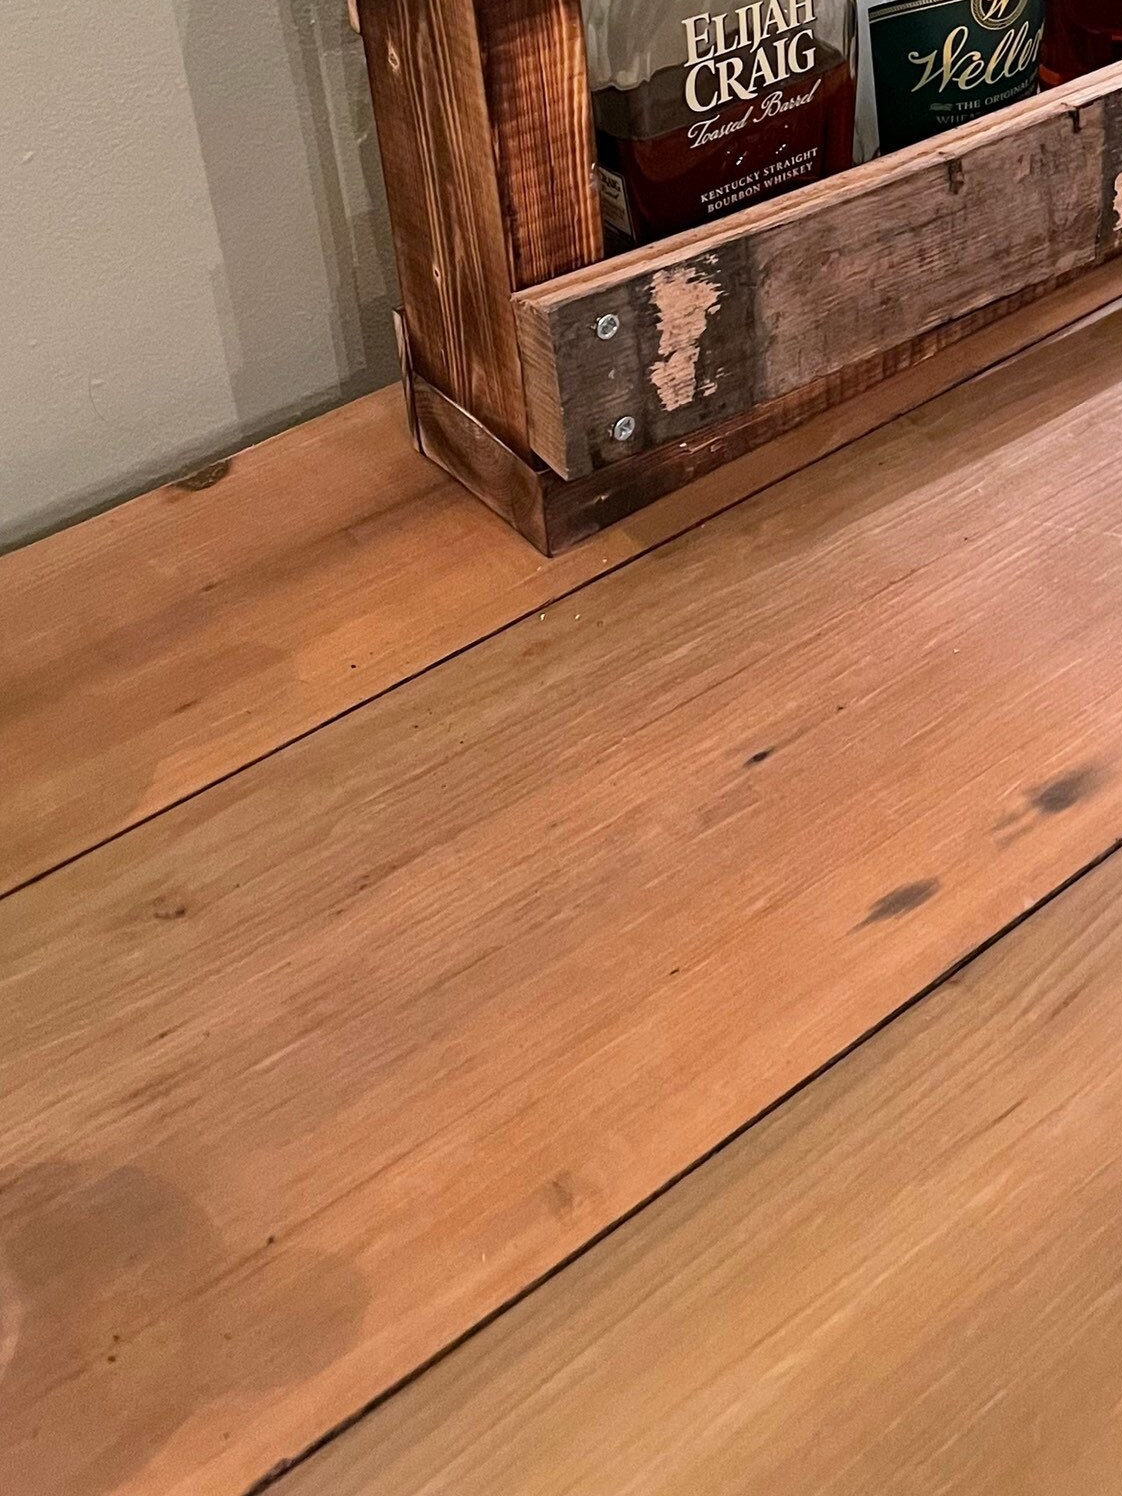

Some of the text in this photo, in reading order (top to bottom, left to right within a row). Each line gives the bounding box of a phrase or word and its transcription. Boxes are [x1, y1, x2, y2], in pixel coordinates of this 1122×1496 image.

[685, 29, 817, 112] CRAIG
[908, 18, 1044, 93] Weller
[687, 78, 822, 149] Toasted Barrel
[956, 100, 981, 111] THE
[985, 79, 1029, 106] ORIGINAL
[700, 147, 818, 203] KENTUCKY STRAIGHT
[707, 162, 813, 213] BOURBON WHISKEY
